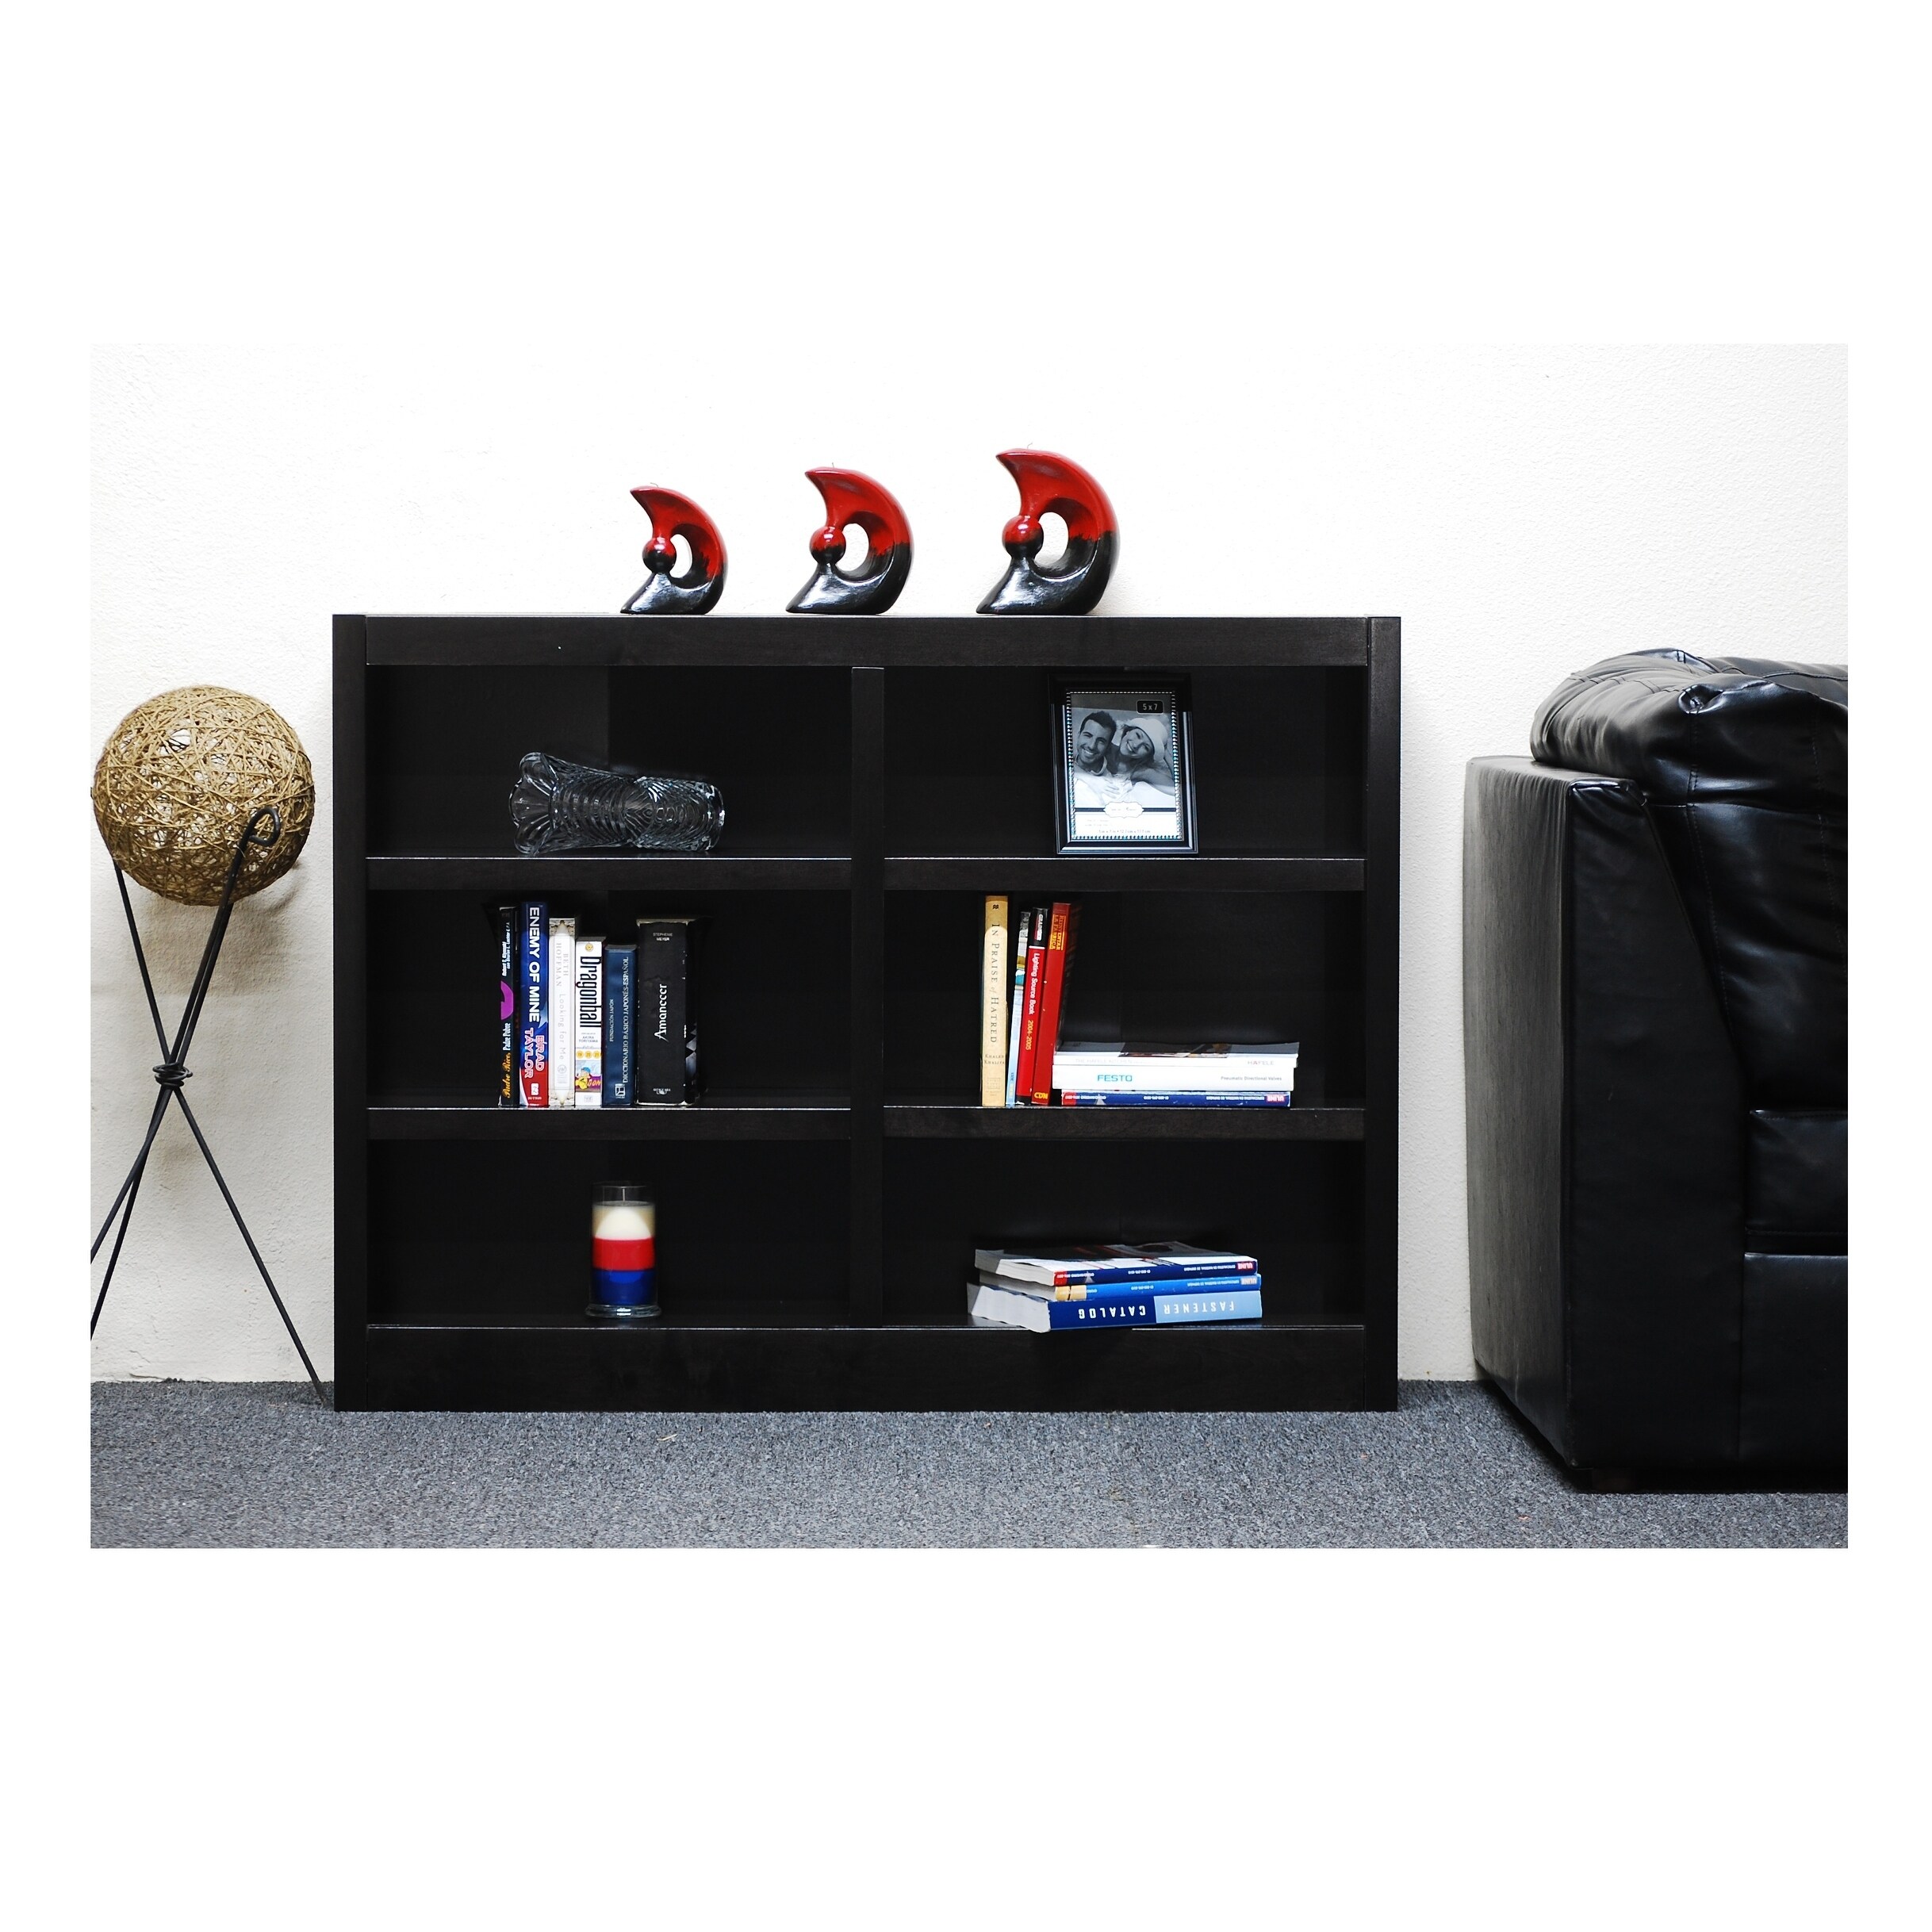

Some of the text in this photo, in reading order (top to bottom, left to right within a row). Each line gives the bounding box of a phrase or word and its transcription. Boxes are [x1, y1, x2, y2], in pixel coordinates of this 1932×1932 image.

[529, 907, 540, 1022] ENEMY OF MINE
[991, 942, 1000, 983] PRAISE
[557, 994, 566, 1028] Looking
[575, 956, 603, 1028] Dragonball
[654, 983, 669, 1042] Amanecer
[1025, 953, 1041, 1051] Lighting Source Book 2004-2005
[991, 997, 999, 1044] HATRED
[524, 1027, 534, 1079] TAYLOR
[535, 1034, 545, 1071] BRAD
[559, 1047, 566, 1060] Me
[1033, 1091, 1048, 1100] CDN
[1077, 1300, 1235, 1321] FASTENER CATALOG
